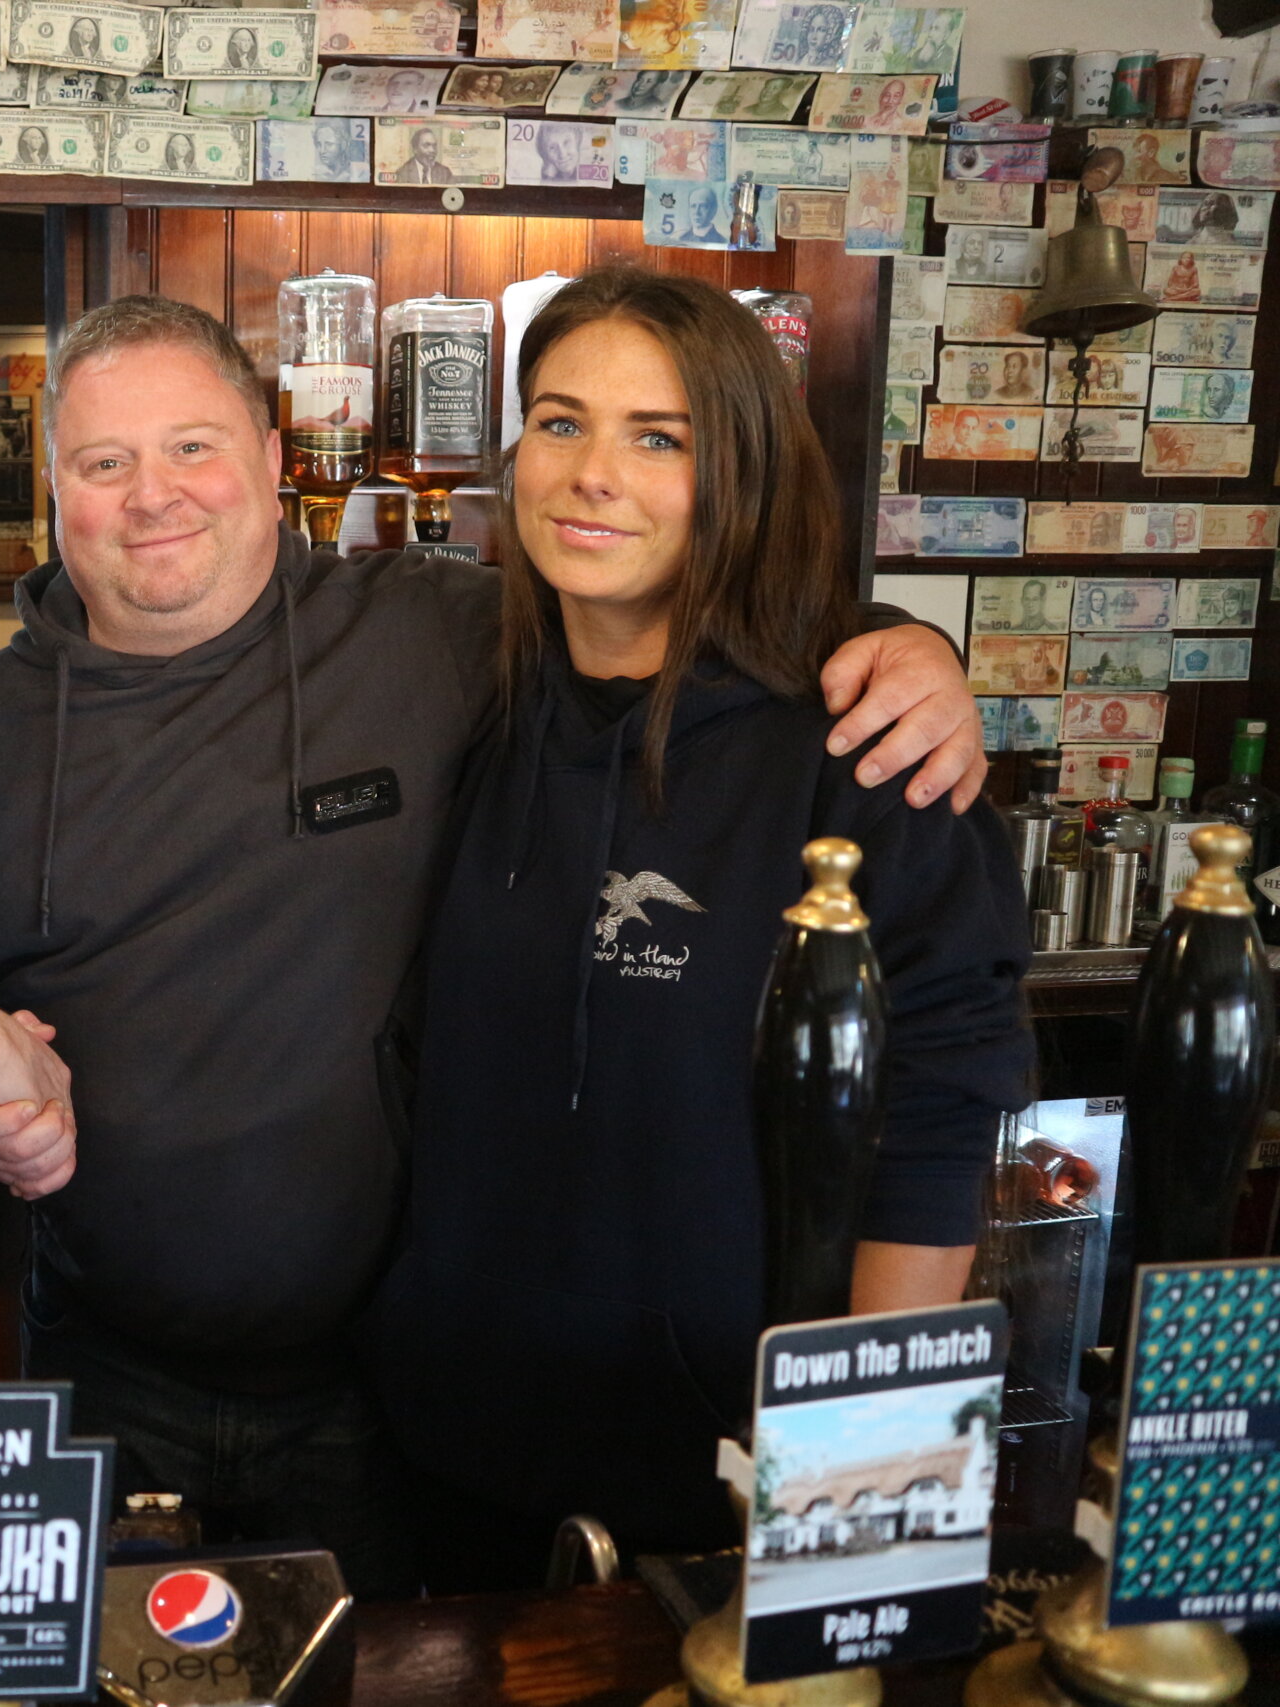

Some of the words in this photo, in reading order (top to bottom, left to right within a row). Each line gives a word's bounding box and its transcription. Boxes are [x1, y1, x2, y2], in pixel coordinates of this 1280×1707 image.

[772, 42, 795, 61] 50
[354, 123, 365, 139] 2
[511, 124, 534, 142] 20
[952, 123, 963, 135] 10
[277, 160, 285, 171] 2
[592, 166, 609, 181] 20
[660, 213, 675, 235] 5
[994, 244, 1005, 263] 2
[767, 318, 807, 337] LEN'S
[418, 345, 444, 367] JACK
[444, 340, 487, 368] DANIEL'S
[970, 362, 989, 374] 20
[319, 376, 362, 386] FAMOUS
[428, 386, 474, 396] Tennessee
[428, 402, 472, 410] WHISKEY
[623, 944, 636, 963] in
[639, 944, 690, 965] Hand
[1105, 1100, 1127, 1113] EM
[774, 1350, 849, 1391] Down
[856, 1339, 900, 1378] the
[907, 1325, 992, 1370] thatch
[823, 1613, 871, 1645] Pale
[874, 1603, 910, 1634] Ale
[137, 1652, 243, 1690] pep
